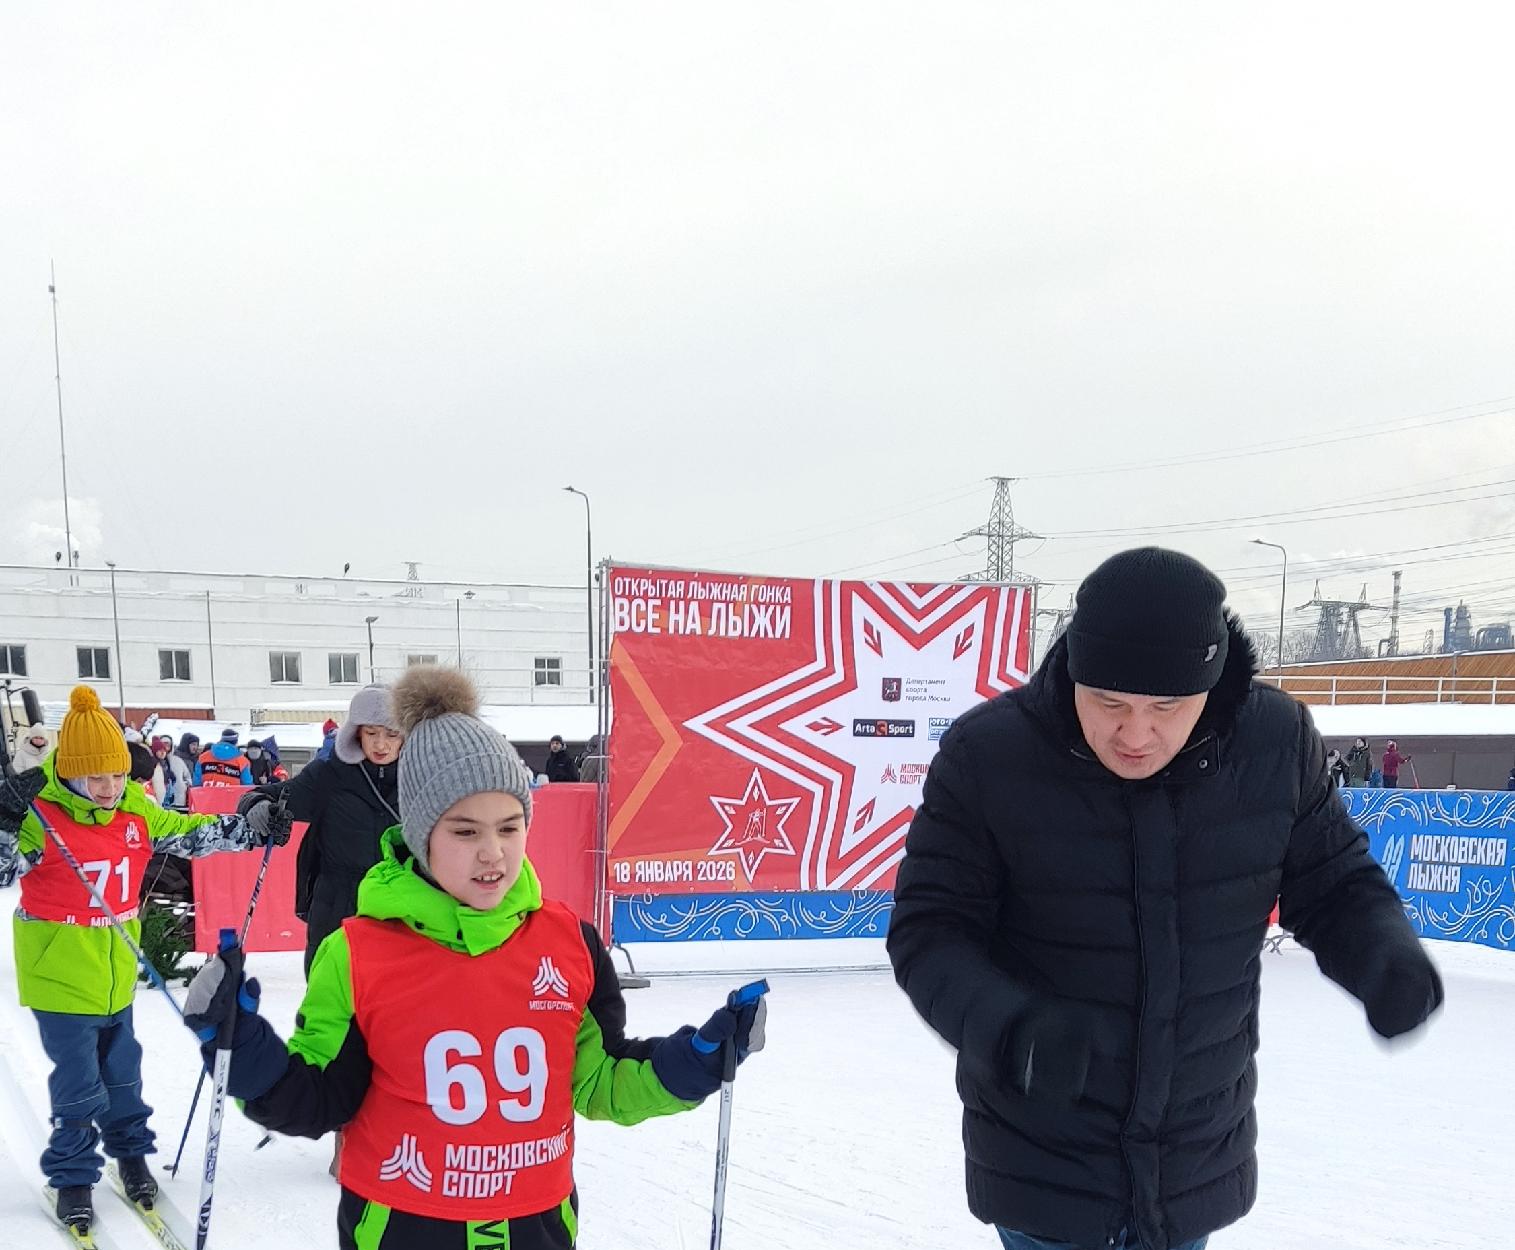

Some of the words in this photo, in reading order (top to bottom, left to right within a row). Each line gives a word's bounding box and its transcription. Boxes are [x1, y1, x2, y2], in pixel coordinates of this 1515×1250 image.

[614, 577, 685, 599] ОТКРЫТАЯ
[687, 581, 747, 602] ЛЫЖНАЯ
[750, 584, 792, 604] ГОНКА
[614, 597, 663, 634] ВСЕ
[668, 600, 703, 636] НА
[707, 602, 792, 639] ЛЫЖИ
[888, 723, 913, 736] Sport
[899, 774, 922, 785] СПОРТ
[1410, 834, 1507, 866] МОСКОВСКАЯ
[82, 856, 130, 908] 71
[613, 862, 631, 883] 18
[635, 860, 693, 883] ЯНВАРЯ
[697, 861, 736, 881] 2026
[1407, 863, 1461, 893] ЛЫЖНЯ
[423, 1026, 549, 1126] 69
[445, 1123, 571, 1169] МОСКОВСКИЙ
[441, 1170, 517, 1199] СПОРТ
